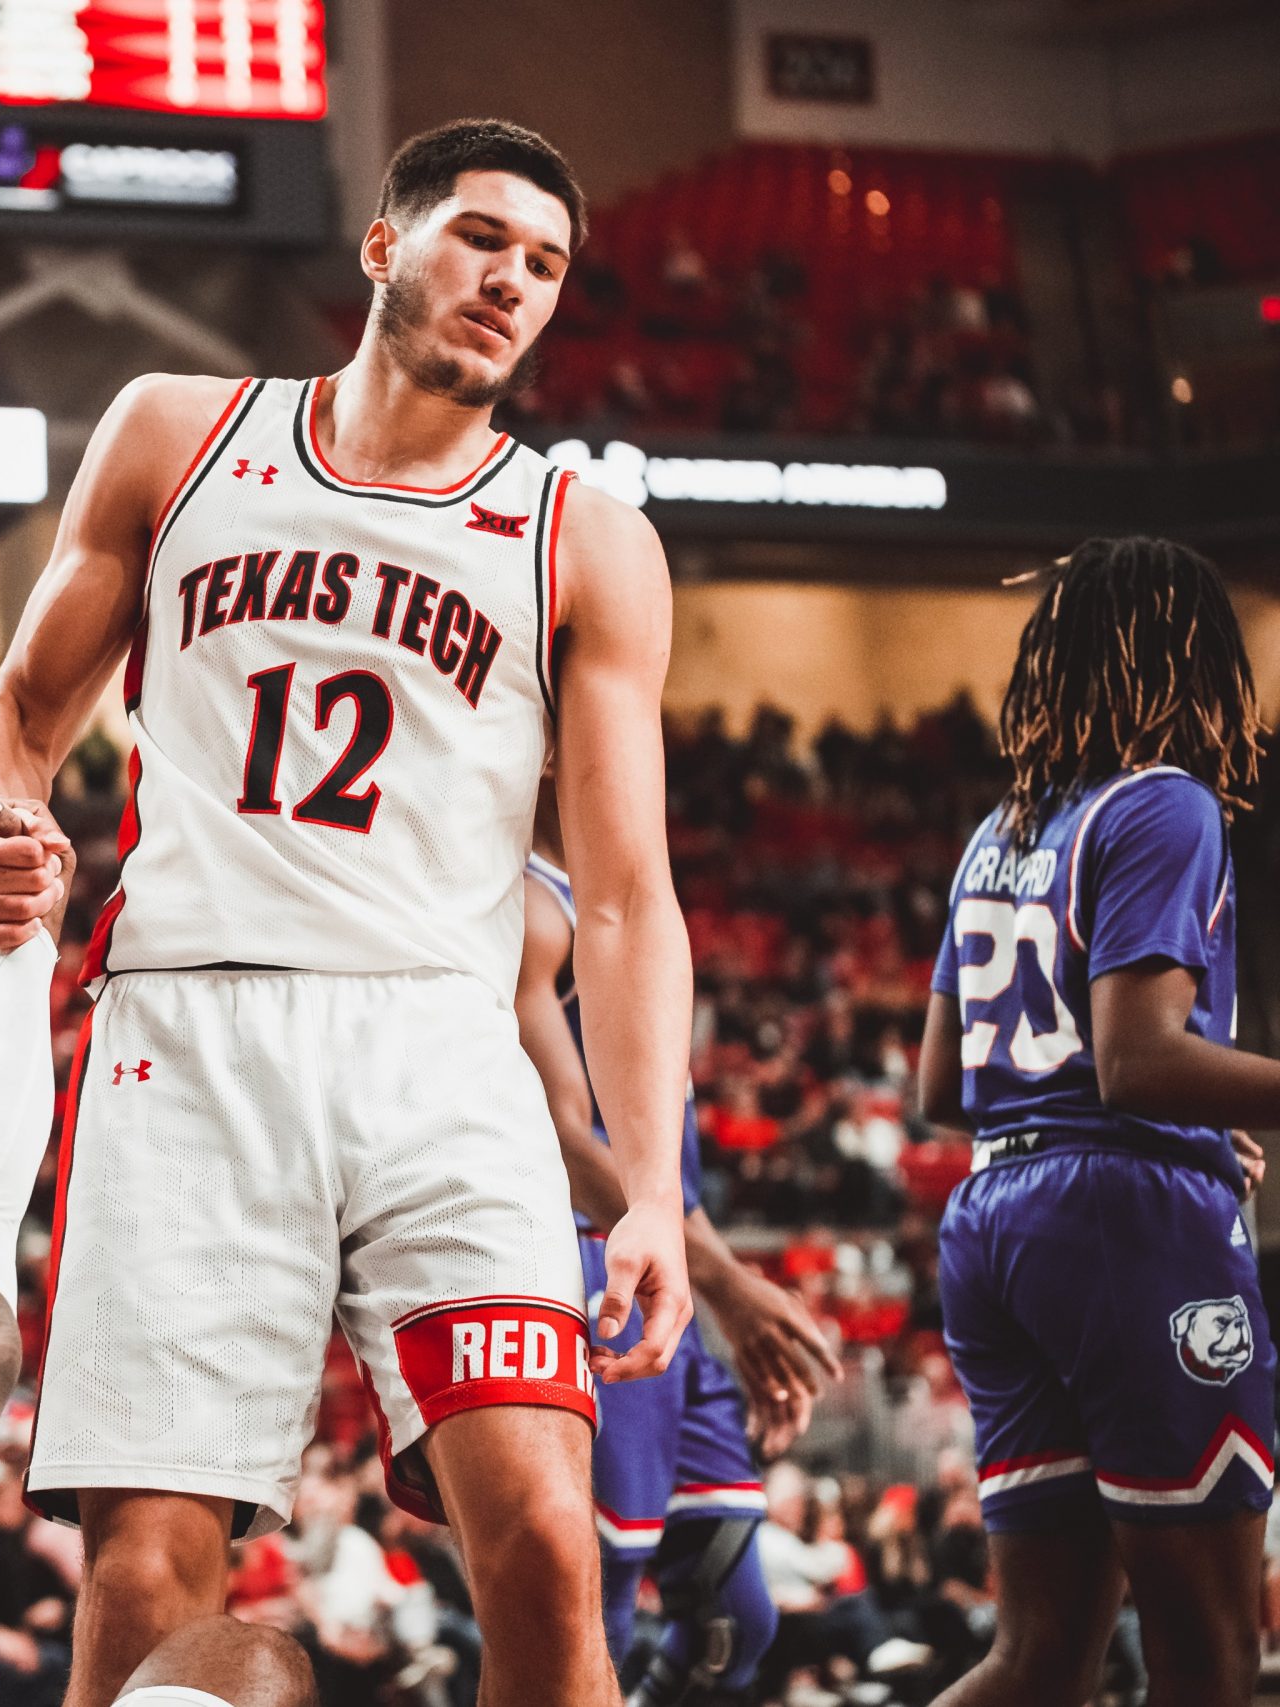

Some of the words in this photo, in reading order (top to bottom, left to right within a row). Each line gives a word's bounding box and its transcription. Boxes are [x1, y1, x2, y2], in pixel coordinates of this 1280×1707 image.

[179, 551, 360, 651] TEXAS
[372, 562, 503, 710] TECH
[237, 662, 393, 834] 12
[954, 899, 1083, 1072] 20
[452, 1320, 559, 1383] RED
